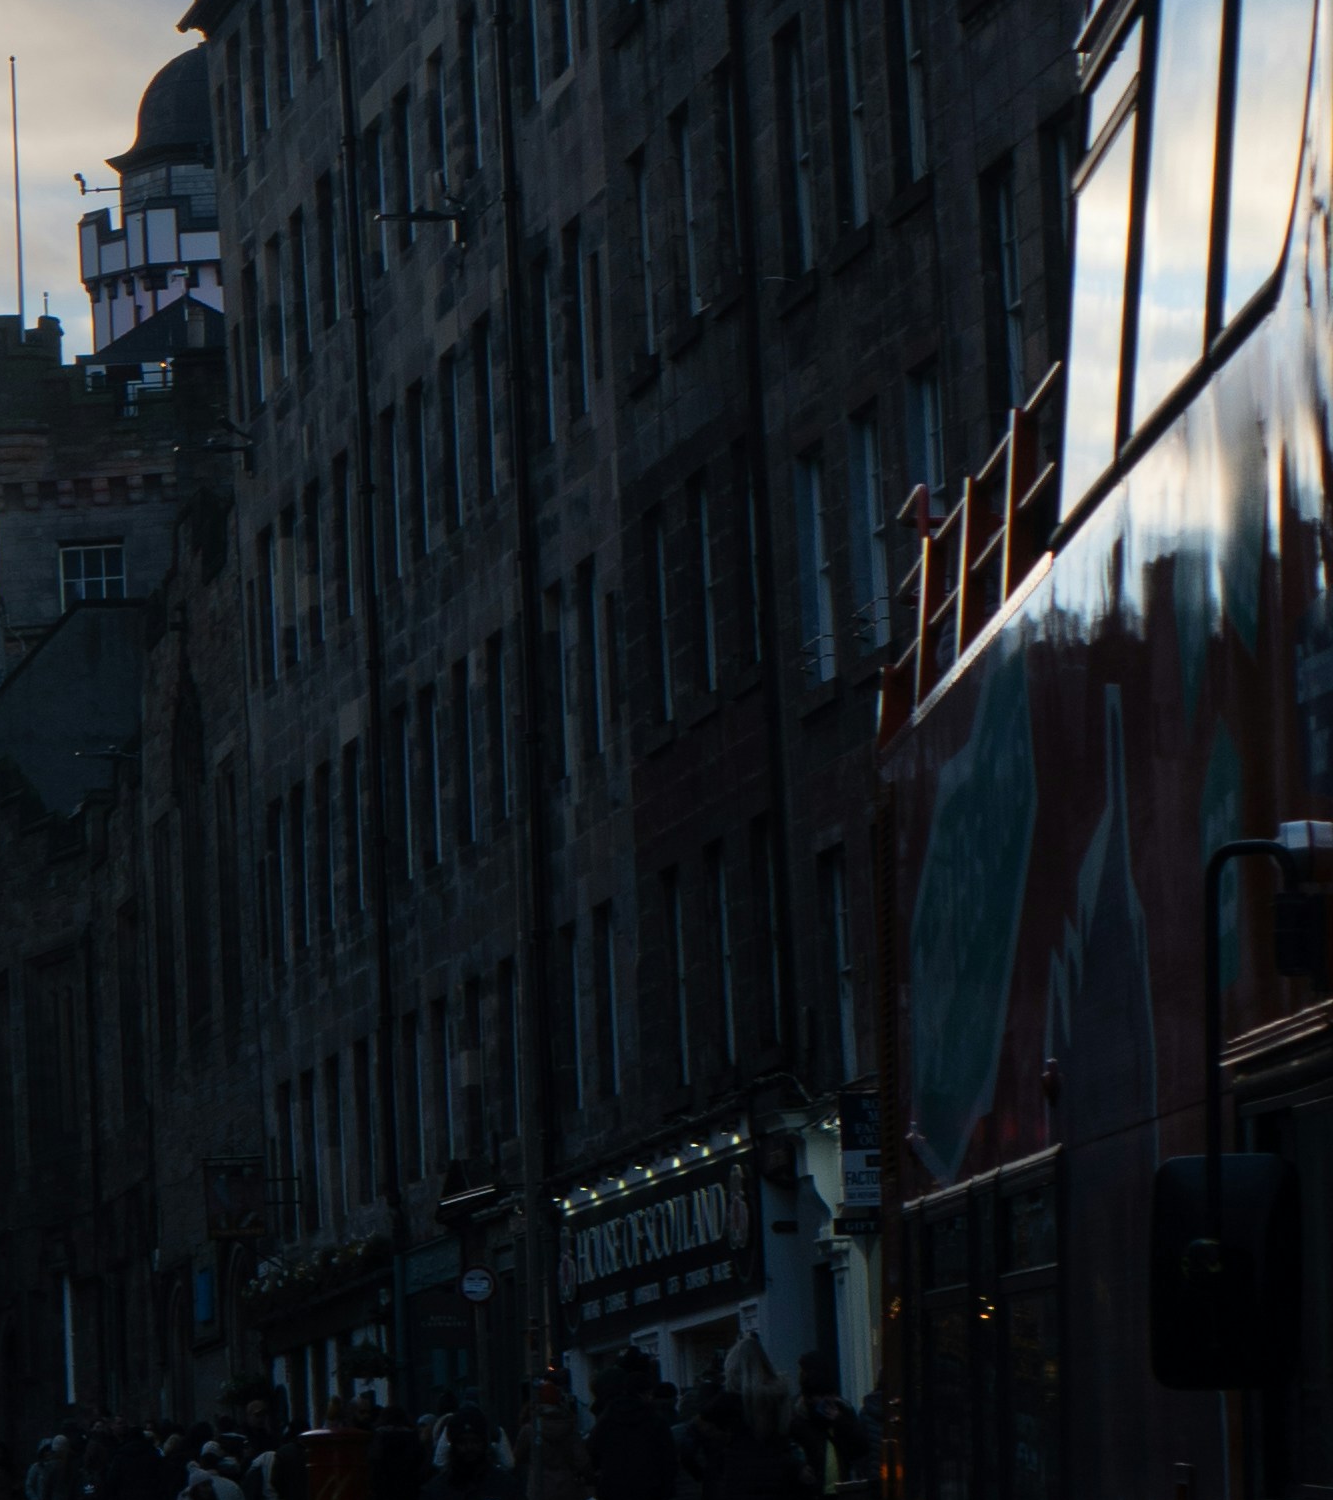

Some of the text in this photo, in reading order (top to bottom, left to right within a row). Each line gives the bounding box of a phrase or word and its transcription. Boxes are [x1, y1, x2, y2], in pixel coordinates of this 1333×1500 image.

[576, 1182, 726, 1285] HOUSE OF SCOTLAND
